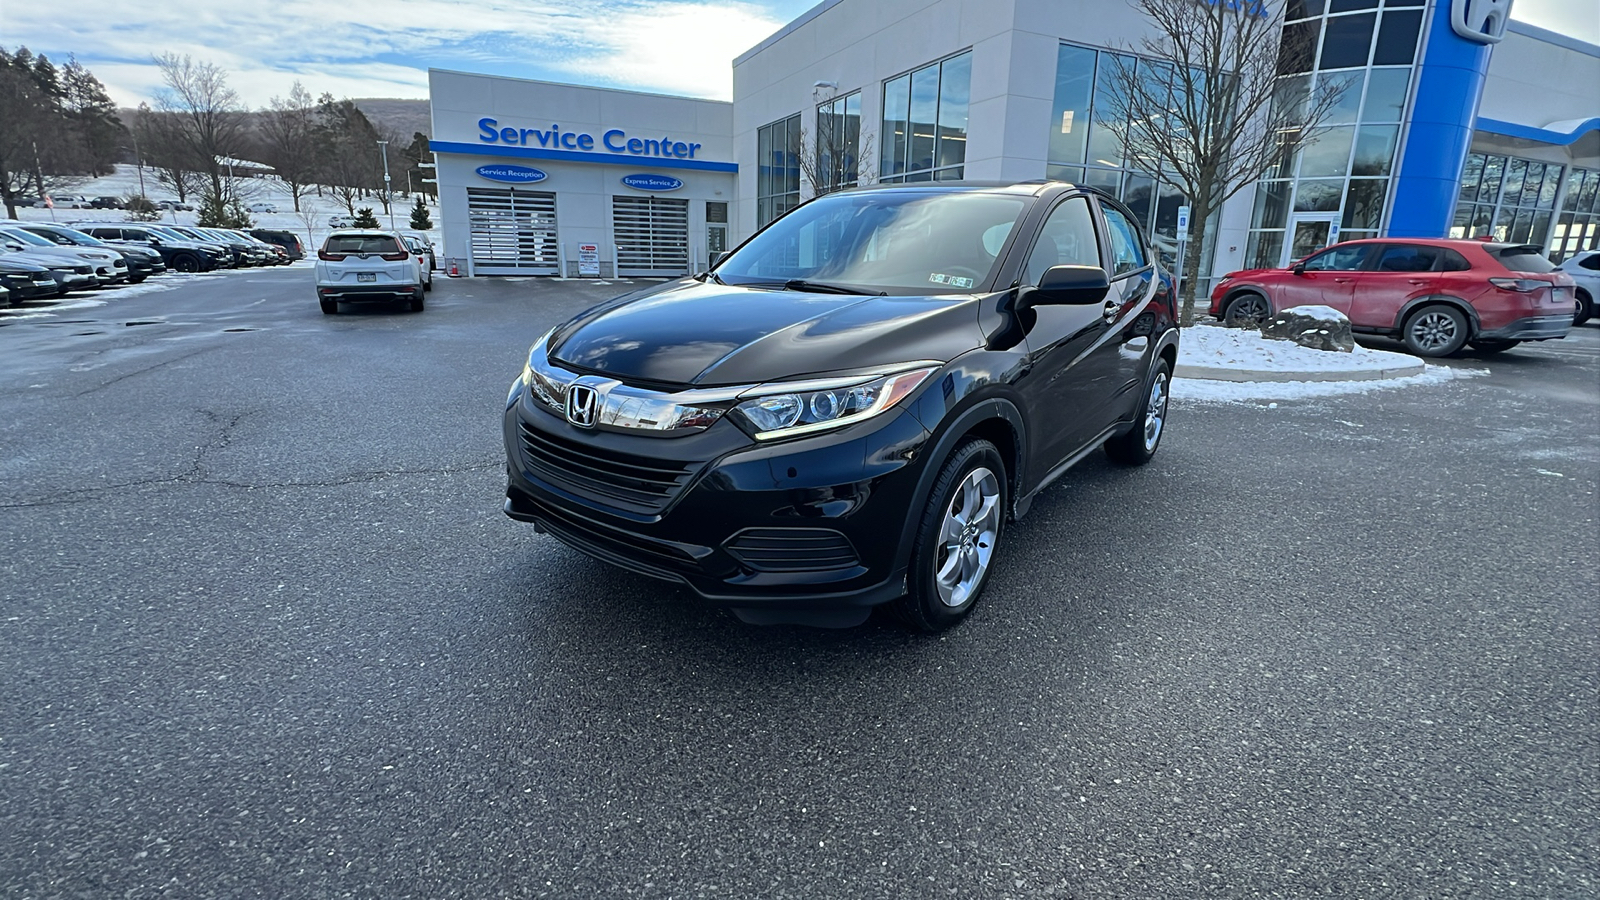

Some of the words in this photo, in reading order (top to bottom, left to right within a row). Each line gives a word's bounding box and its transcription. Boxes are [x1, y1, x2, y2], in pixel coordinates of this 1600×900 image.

[478, 118, 594, 150] Service
[603, 129, 702, 159] Center
[480, 168, 507, 176] Service
[508, 170, 543, 178] Reception
[625, 178, 648, 186] Express
